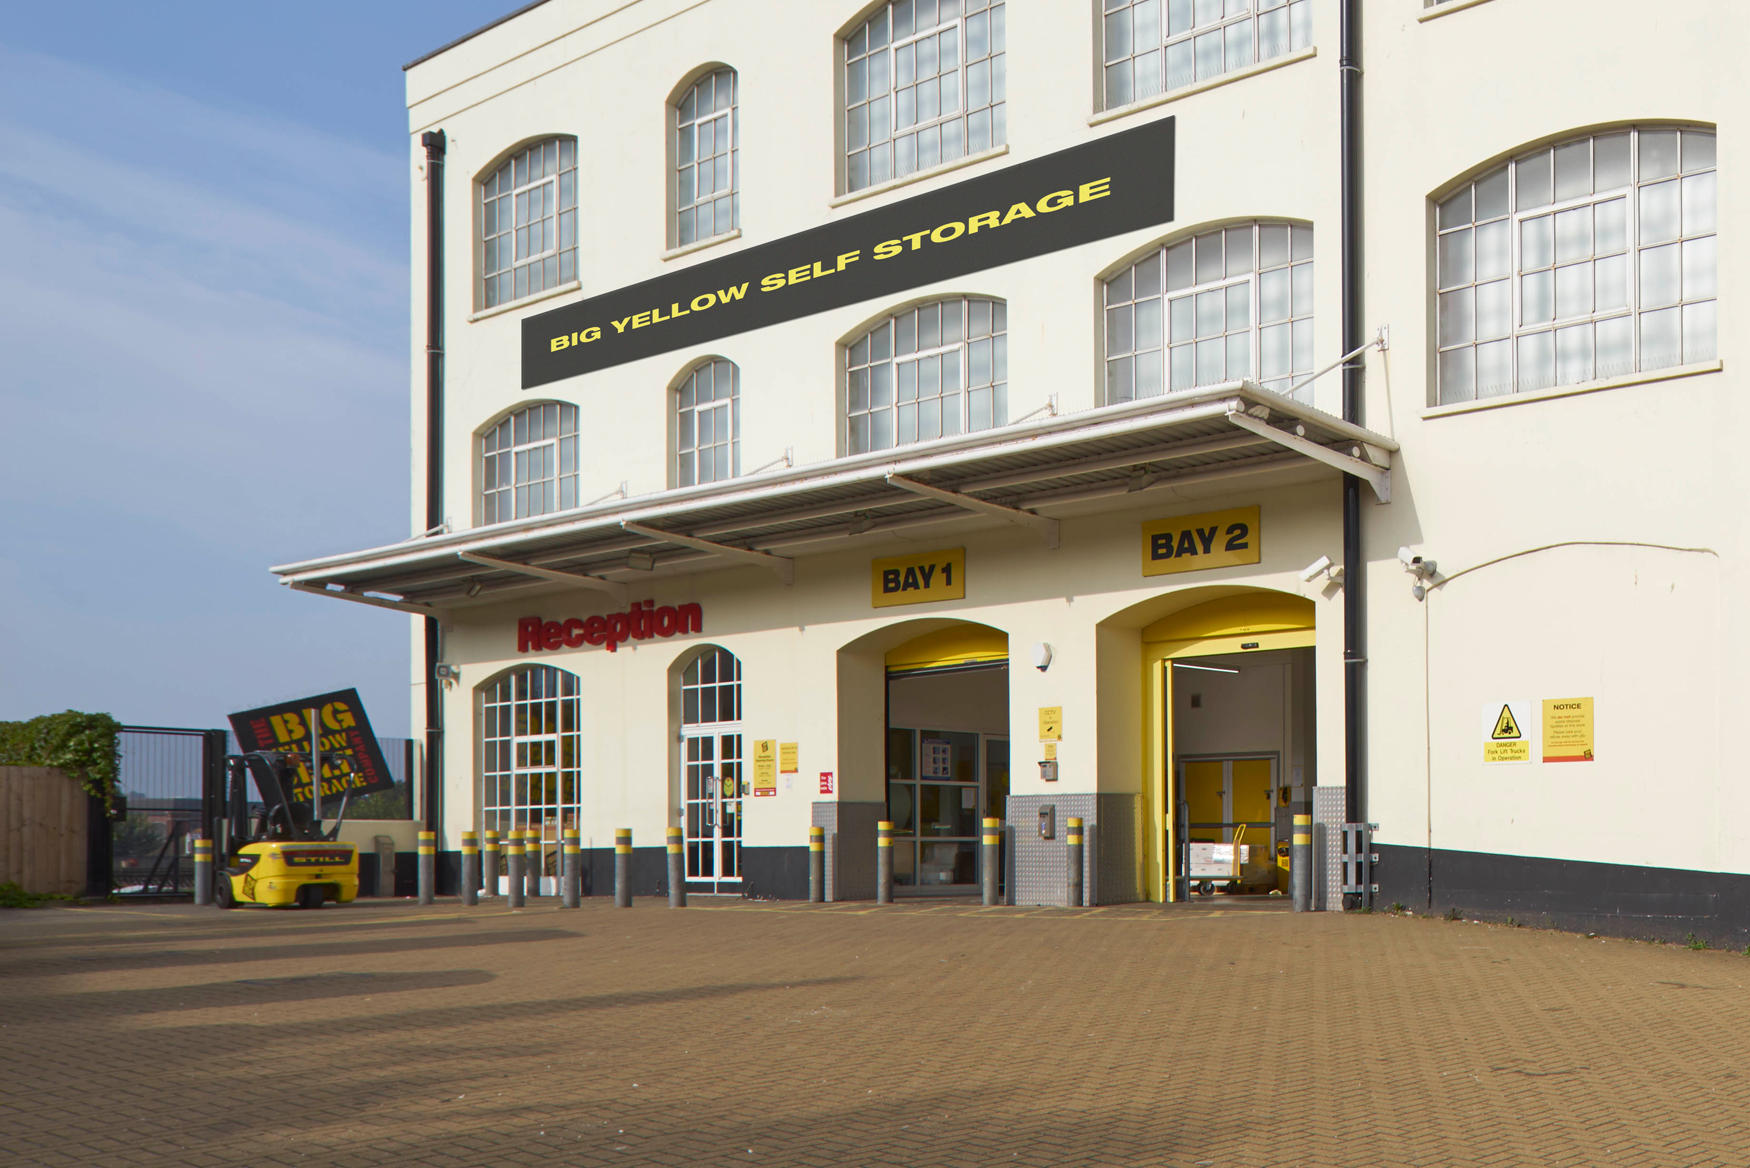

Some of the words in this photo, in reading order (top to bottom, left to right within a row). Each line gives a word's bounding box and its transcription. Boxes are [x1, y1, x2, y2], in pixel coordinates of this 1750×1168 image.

[550, 326, 601, 353] BIG
[610, 282, 750, 334] YELLOW
[760, 250, 861, 293] SELF
[873, 176, 1111, 260] STORAGE
[1151, 526, 1219, 561] BAY
[1225, 523, 1249, 552] 2
[883, 564, 936, 594] BAY
[941, 562, 952, 587] 1
[517, 599, 703, 654] Reception
[269, 701, 356, 744] BIG
